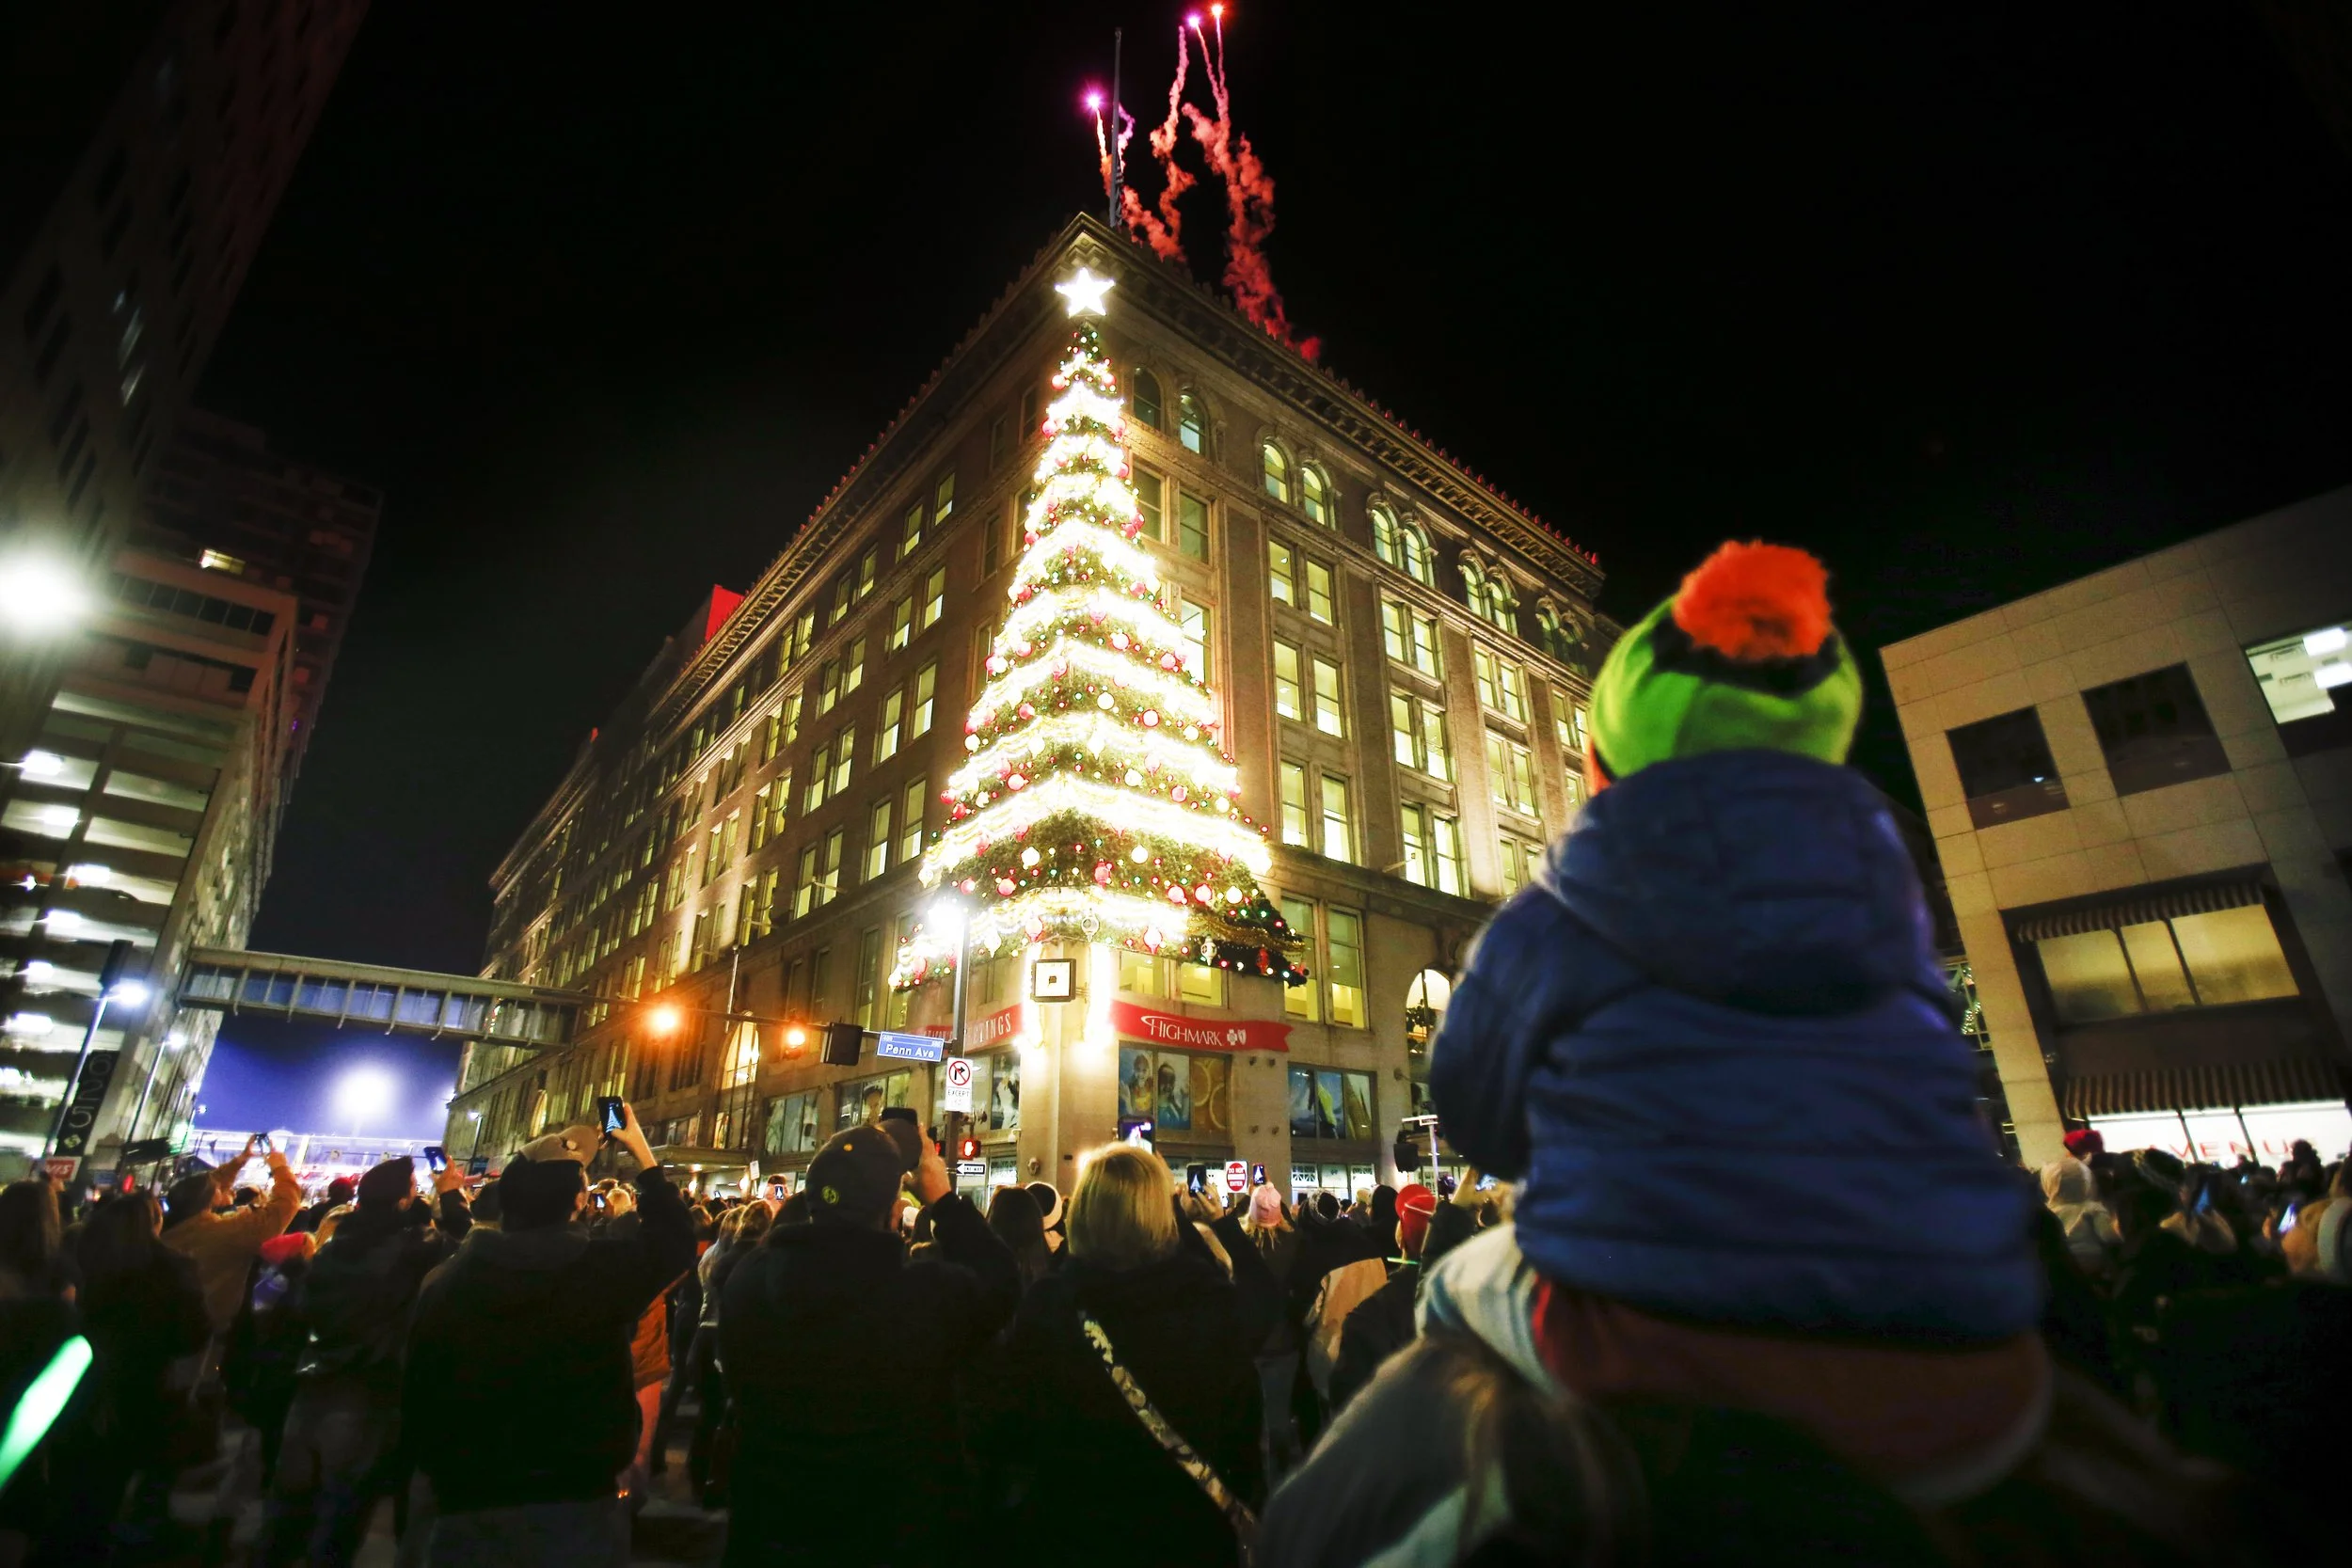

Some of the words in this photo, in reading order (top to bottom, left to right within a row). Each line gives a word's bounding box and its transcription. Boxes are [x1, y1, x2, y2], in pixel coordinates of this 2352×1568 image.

[1141, 1016, 1222, 1046] HIGHMARK
[885, 1043, 912, 1056] Penn
[914, 1047, 934, 1058] Ave
